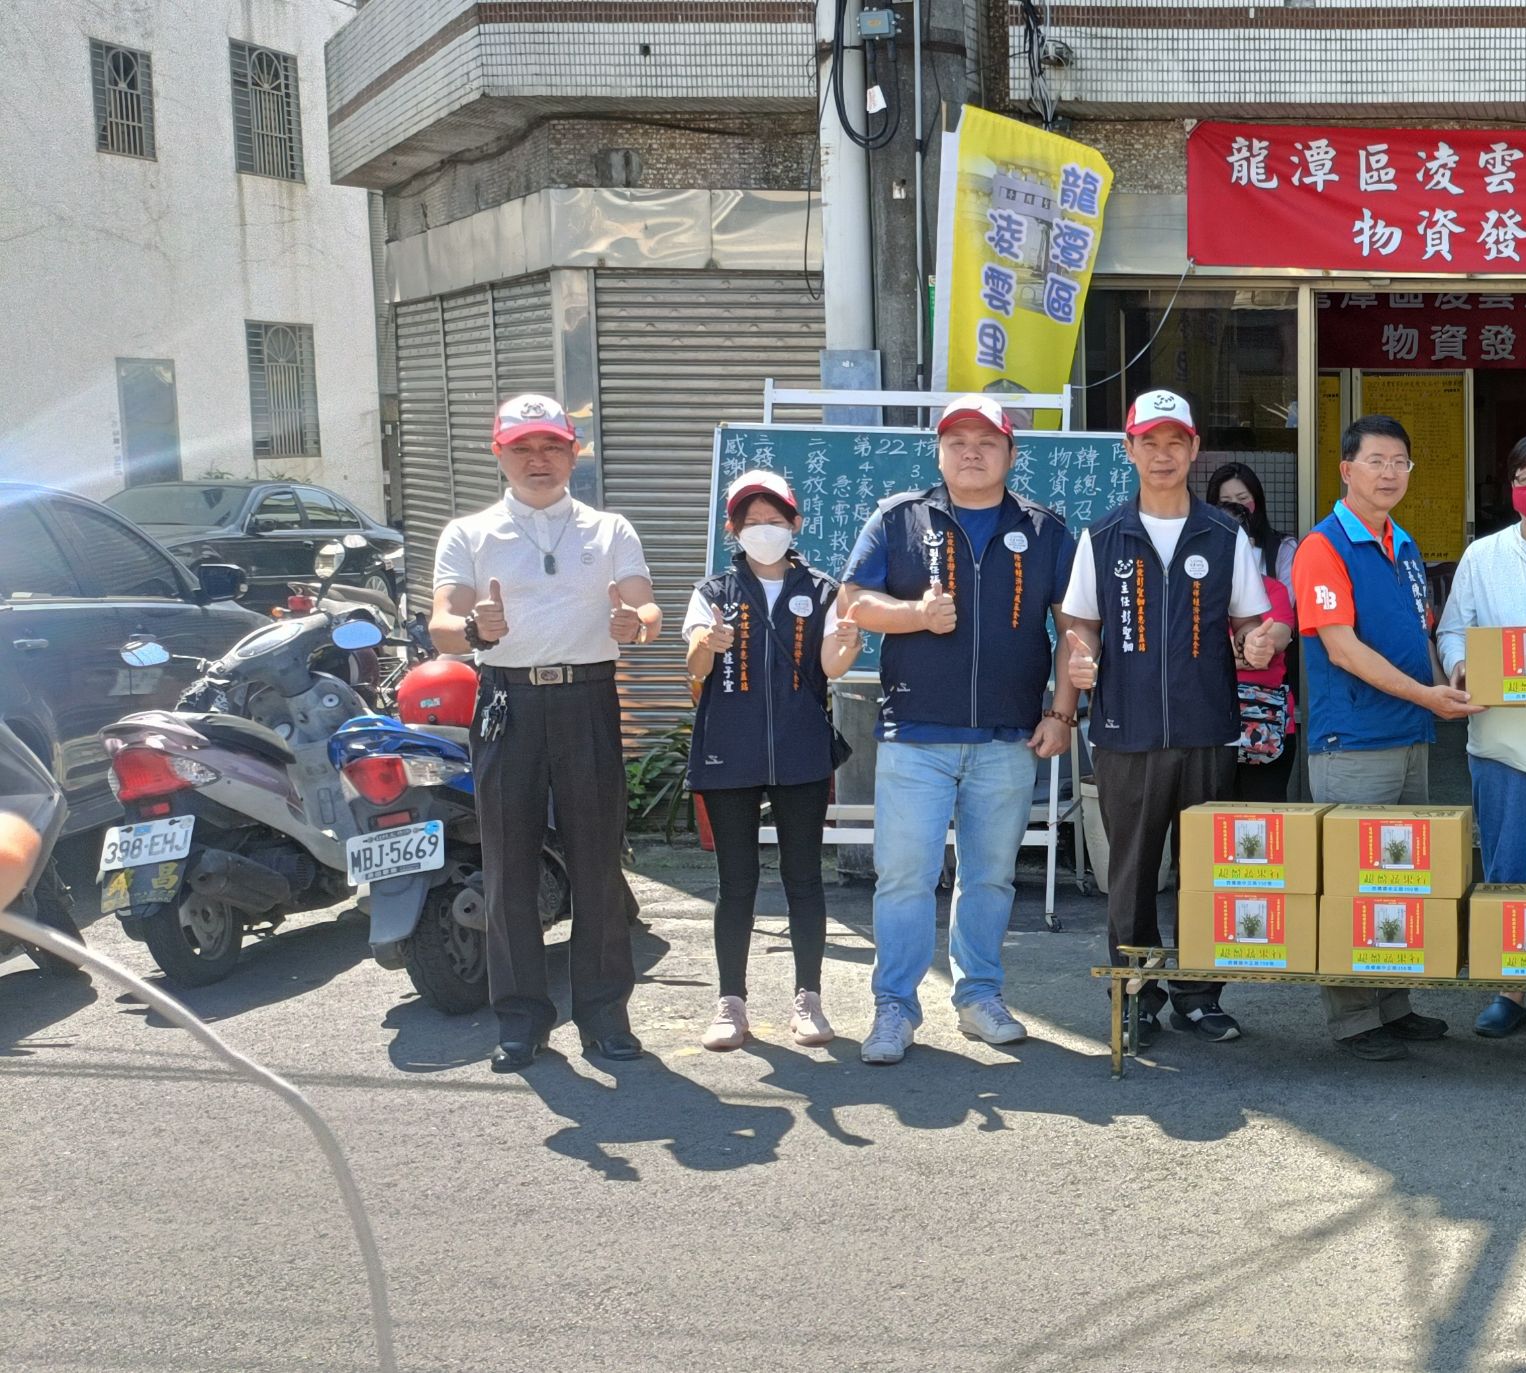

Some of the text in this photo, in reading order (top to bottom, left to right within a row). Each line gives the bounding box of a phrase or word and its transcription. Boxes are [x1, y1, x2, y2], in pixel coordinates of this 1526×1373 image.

[975, 210, 1026, 370] 凌雲里
[1043, 165, 1101, 325] 龍潭區
[104, 829, 189, 864] 398-EHJ
[350, 834, 440, 875] MBJ-5669
